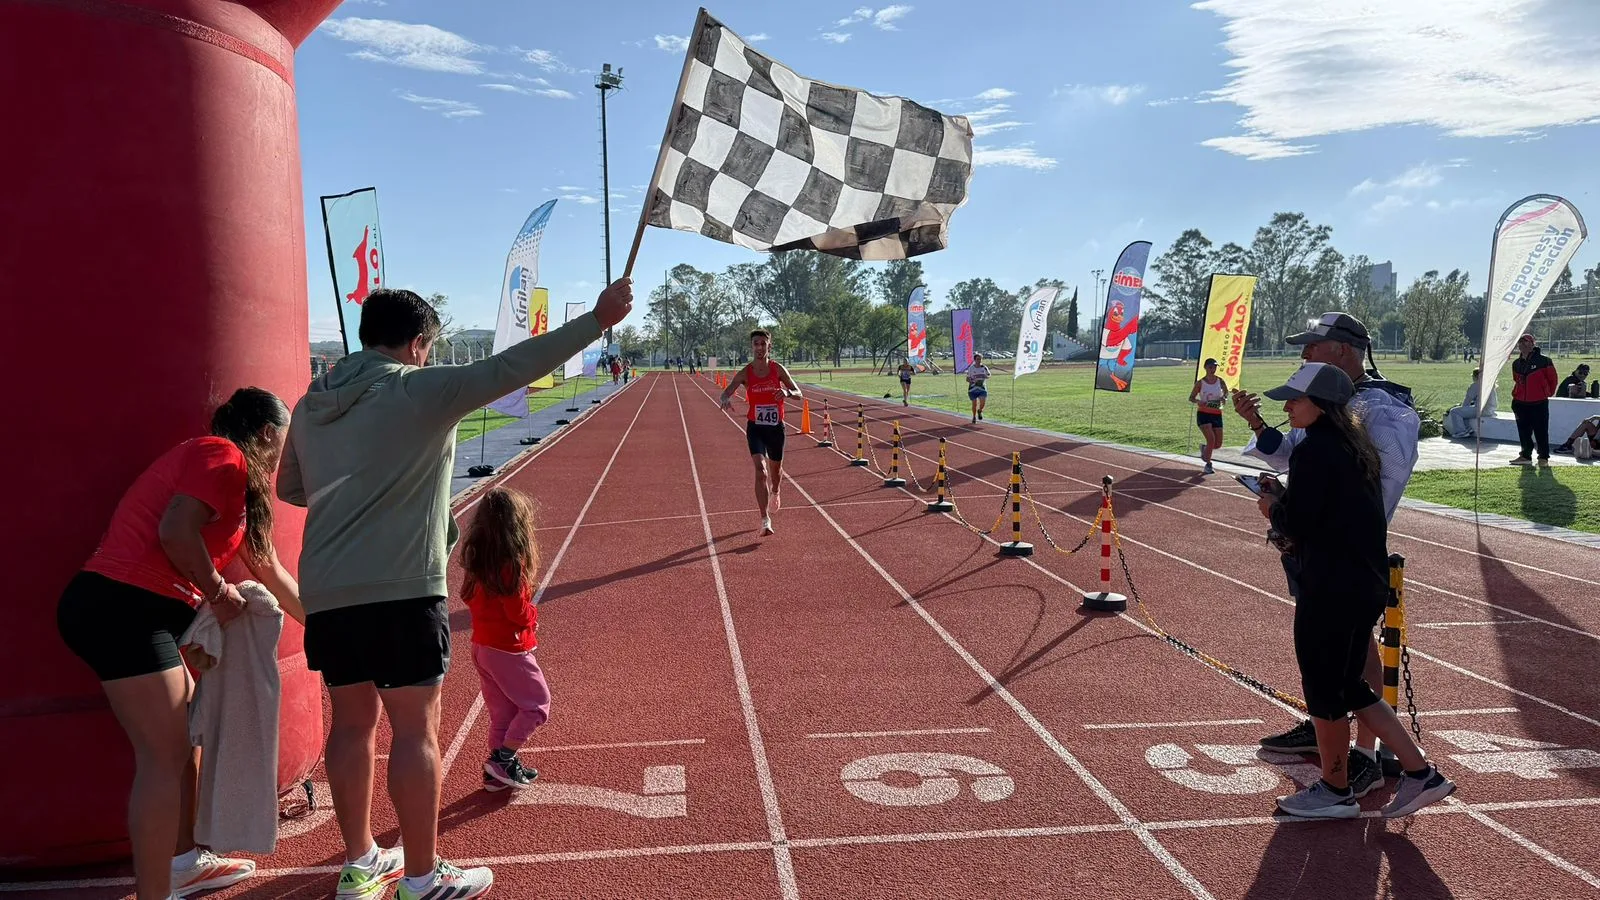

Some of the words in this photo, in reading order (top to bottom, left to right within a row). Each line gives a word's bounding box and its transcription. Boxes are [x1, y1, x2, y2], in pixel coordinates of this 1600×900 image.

[1502, 236, 1551, 304] Deportes
[1545, 225, 1560, 236] y
[515, 267, 529, 329] Kirilan
[1034, 299, 1047, 331] Kirilan
[1023, 340, 1039, 354] 50
[1220, 334, 1230, 372] EXPRESO
[1226, 304, 1247, 377] GONZALO
[757, 411, 778, 423] 449
[840, 752, 1015, 807] 6
[1429, 729, 1600, 779] 4
[507, 765, 687, 819] 7
